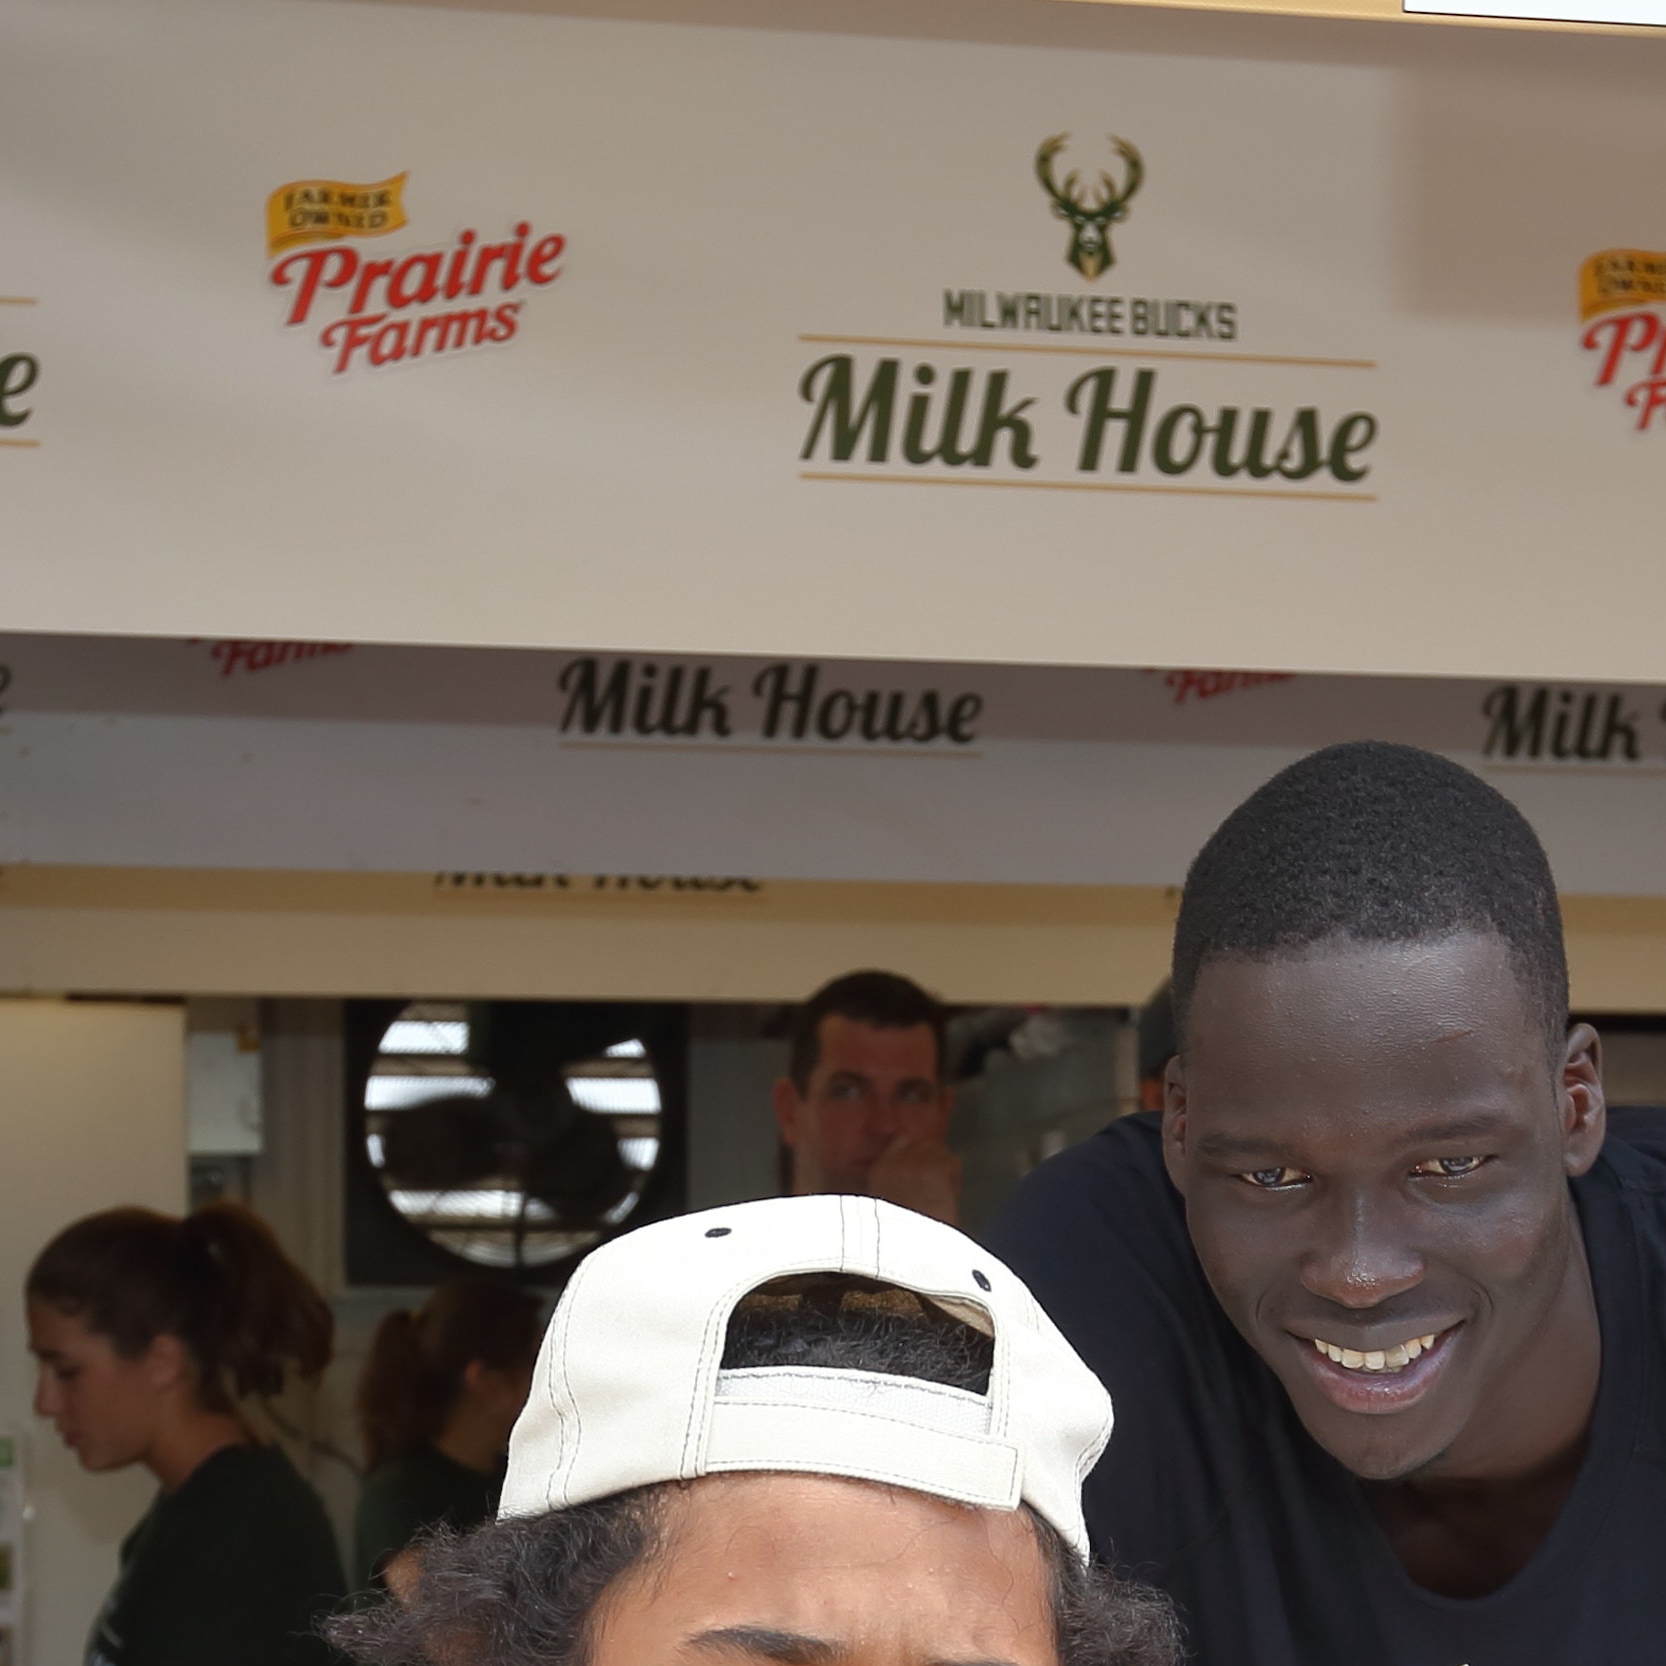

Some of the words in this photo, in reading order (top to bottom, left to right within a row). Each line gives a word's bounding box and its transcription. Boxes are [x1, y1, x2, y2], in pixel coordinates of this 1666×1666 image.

[269, 220, 567, 327] Prairie
[943, 288, 1126, 336] MILWAUKEE
[1132, 300, 1238, 342] BUCKS
[320, 301, 521, 374] Farms
[798, 353, 1040, 470] Milk
[1064, 365, 1380, 484] House
[557, 656, 733, 739] Milk
[752, 662, 983, 745] House
[1481, 682, 1641, 766] Milk
